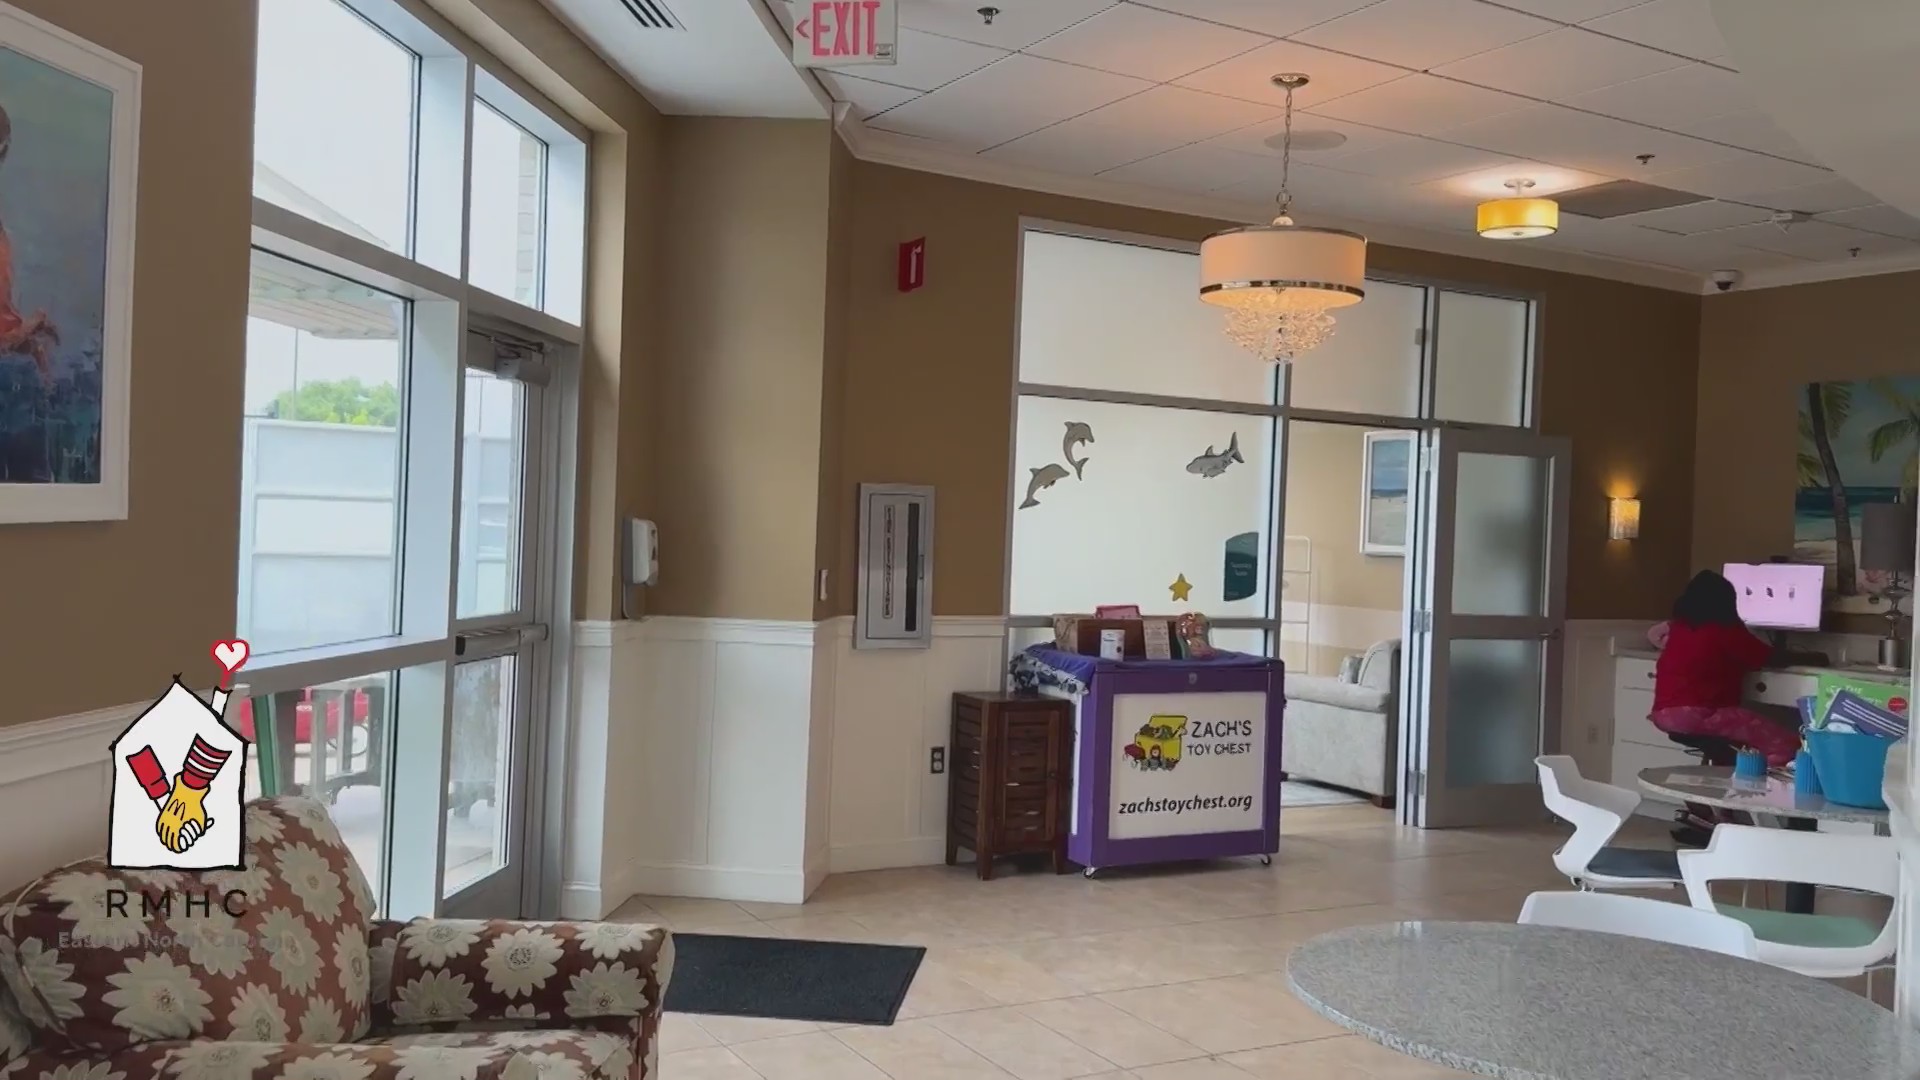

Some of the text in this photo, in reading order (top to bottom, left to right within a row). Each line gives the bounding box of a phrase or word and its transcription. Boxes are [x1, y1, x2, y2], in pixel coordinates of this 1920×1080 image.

[812, 1, 881, 56] EXIT
[1191, 719, 1252, 738] ZACH'S
[1186, 742, 1252, 756] TOY CHEST
[1118, 794, 1253, 815] zachstoychest.org
